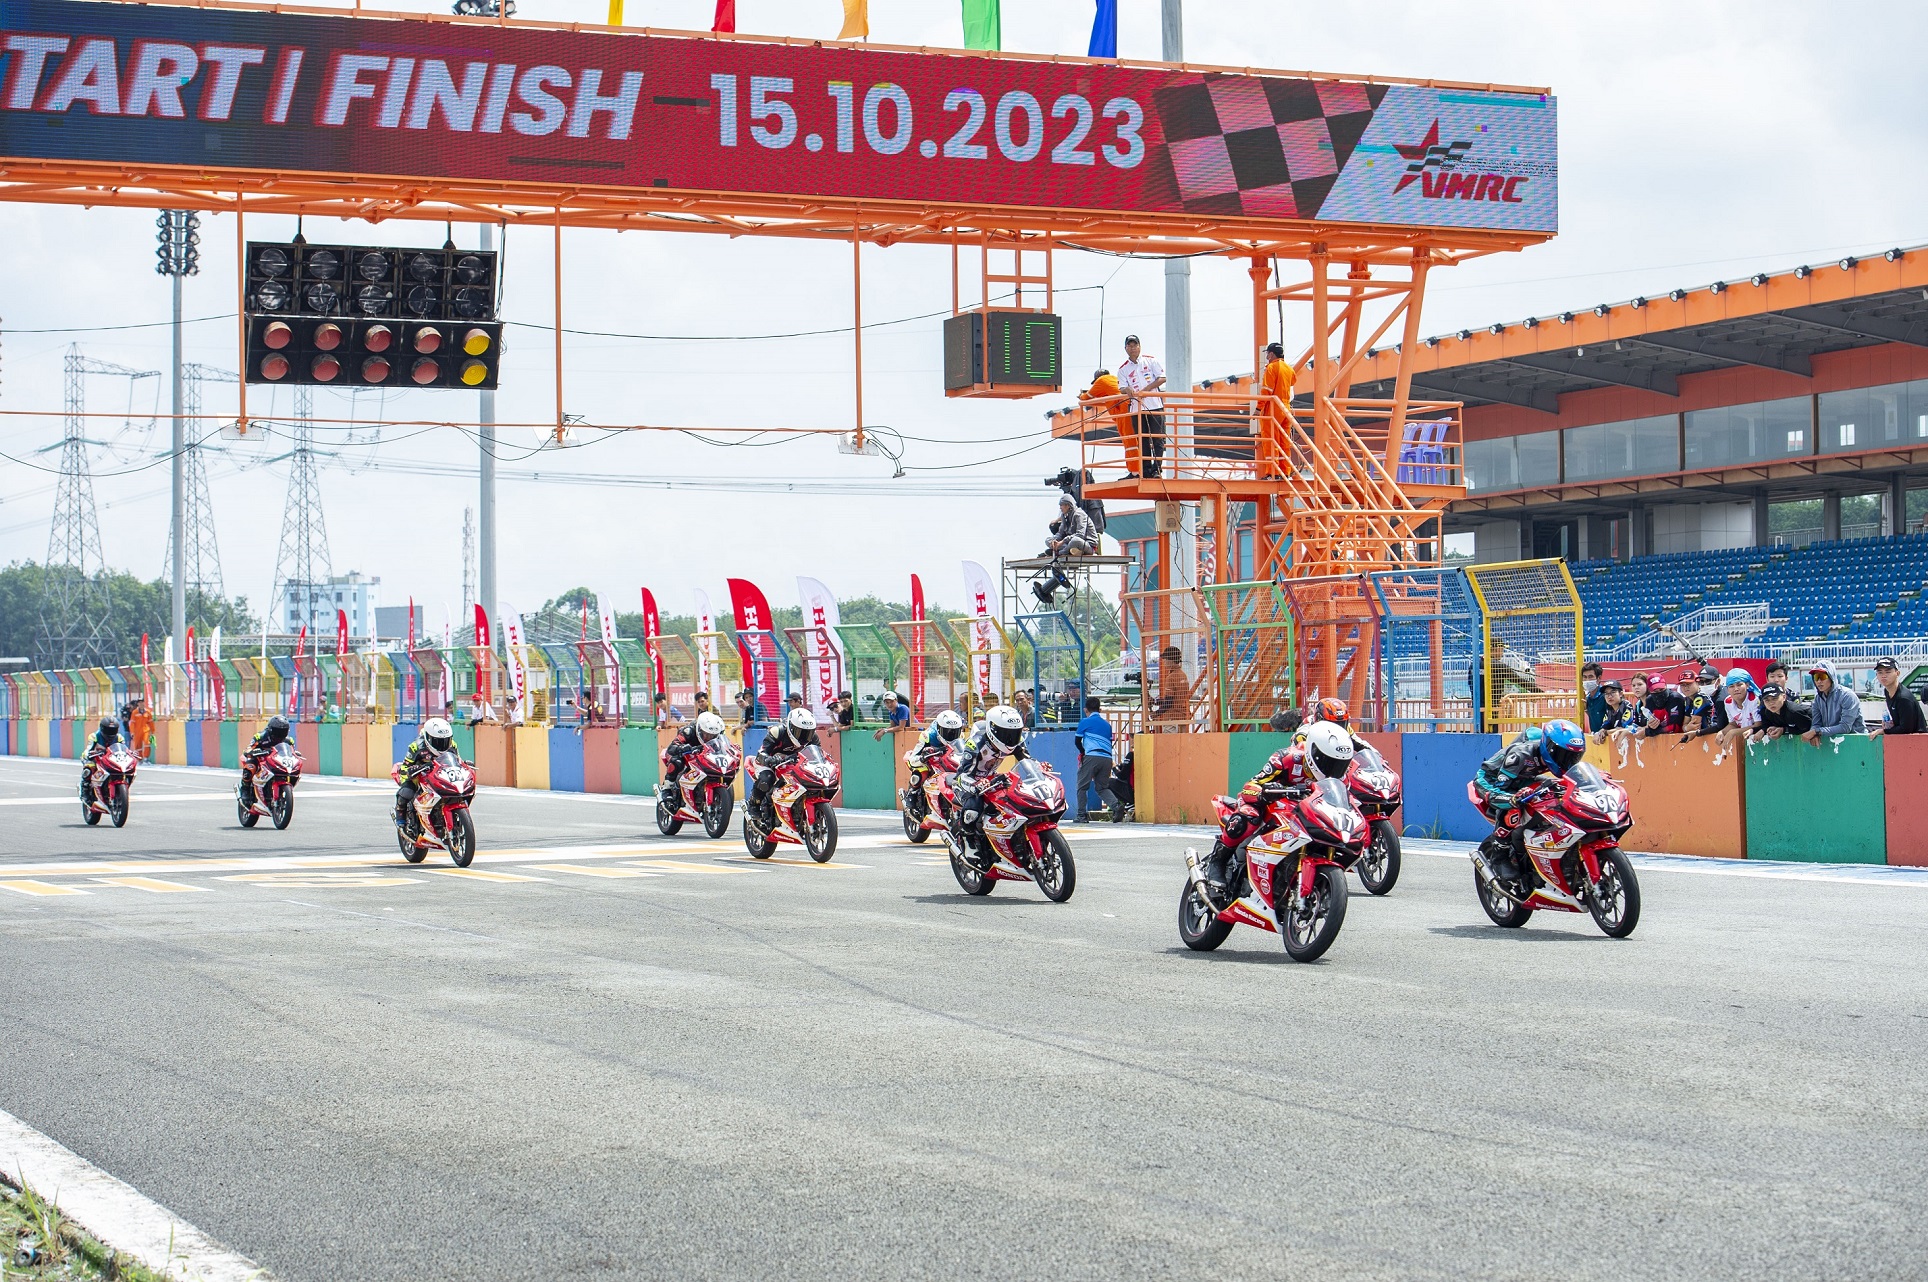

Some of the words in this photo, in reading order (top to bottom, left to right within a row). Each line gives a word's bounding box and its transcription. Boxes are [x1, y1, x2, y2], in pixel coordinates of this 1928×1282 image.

[320, 54, 643, 140] FINISH
[710, 73, 1146, 169] 15.10.2023
[1421, 171, 1530, 203] VMRC
[1004, 321, 1056, 378] 10
[813, 606, 833, 704] HONDA
[717, 757, 728, 768] 16
[1371, 776, 1390, 790] 22
[1596, 795, 1617, 813] 96
[1337, 813, 1354, 832] 17
